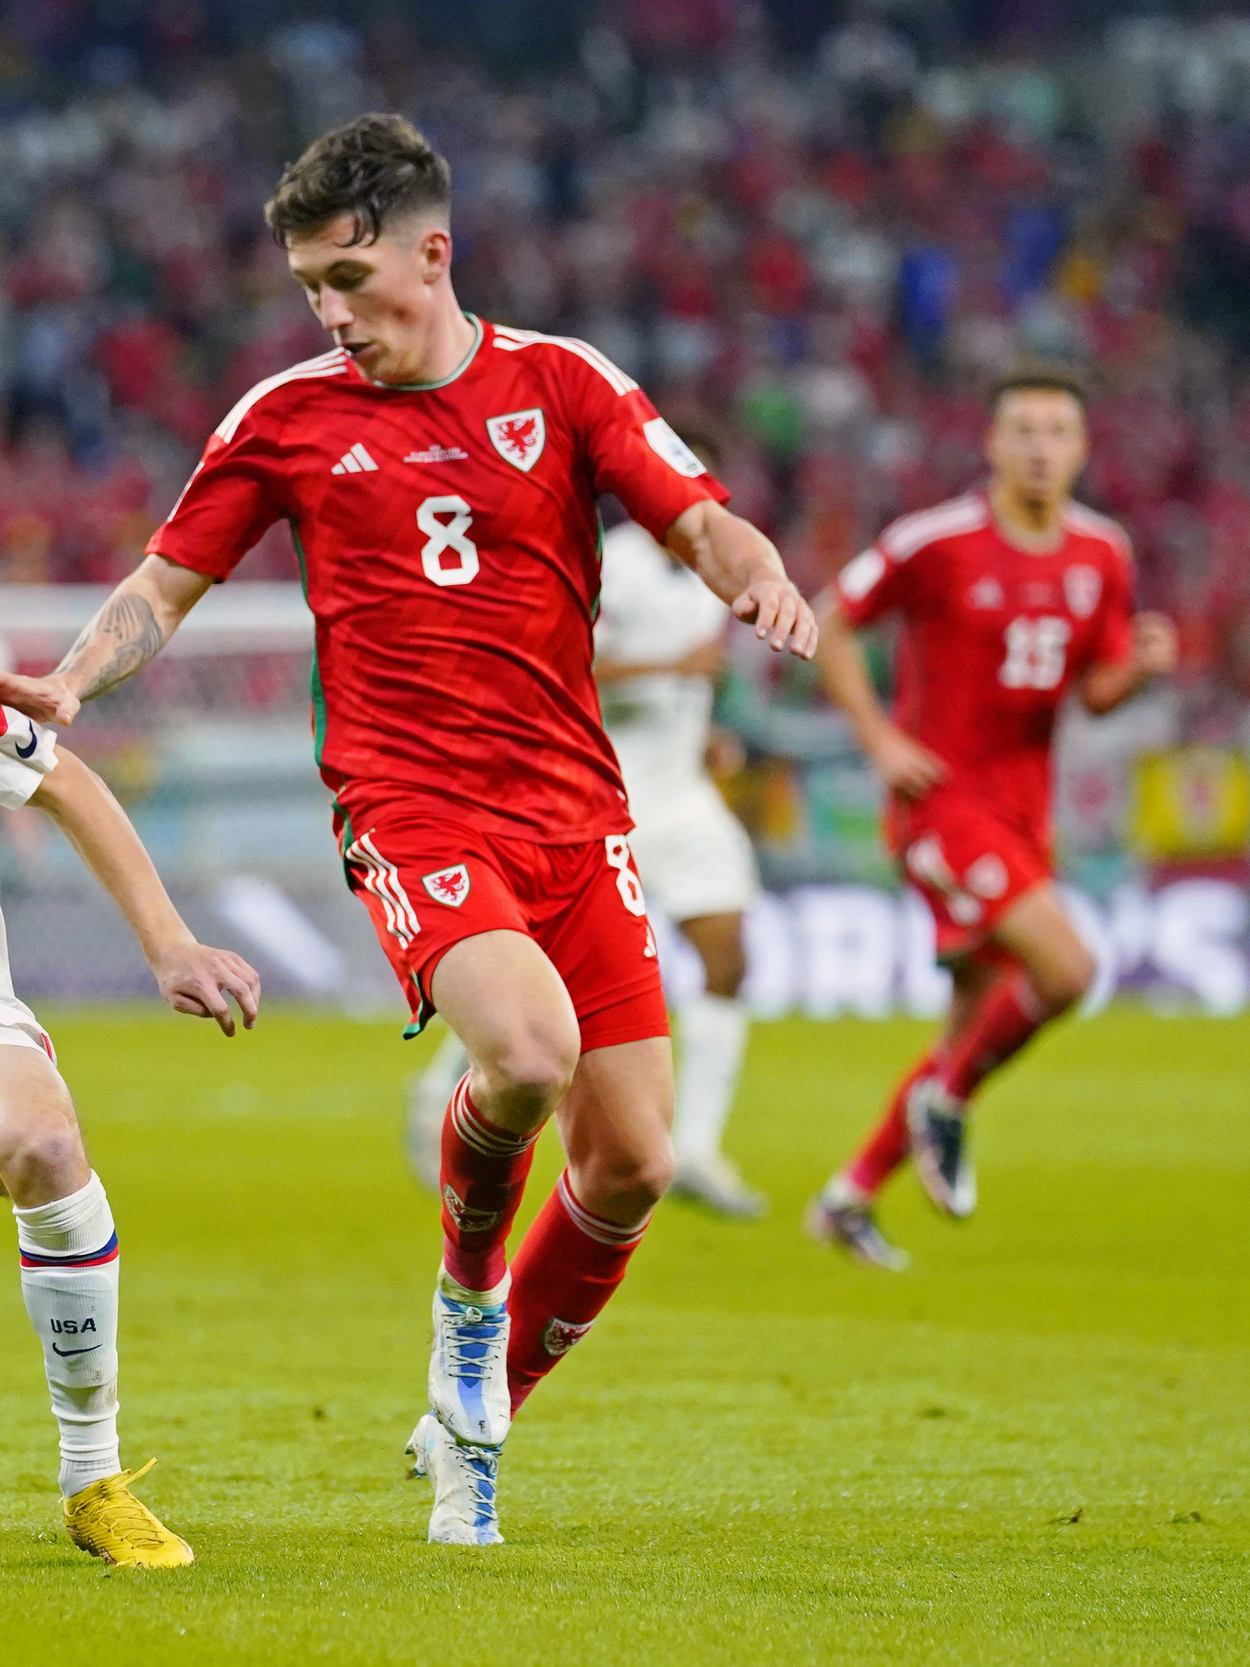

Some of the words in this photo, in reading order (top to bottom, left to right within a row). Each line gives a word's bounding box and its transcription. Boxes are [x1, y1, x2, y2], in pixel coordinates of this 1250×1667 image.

[416, 495, 480, 587] 8
[605, 834, 647, 917] 8
[50, 1317, 97, 1335] USA
